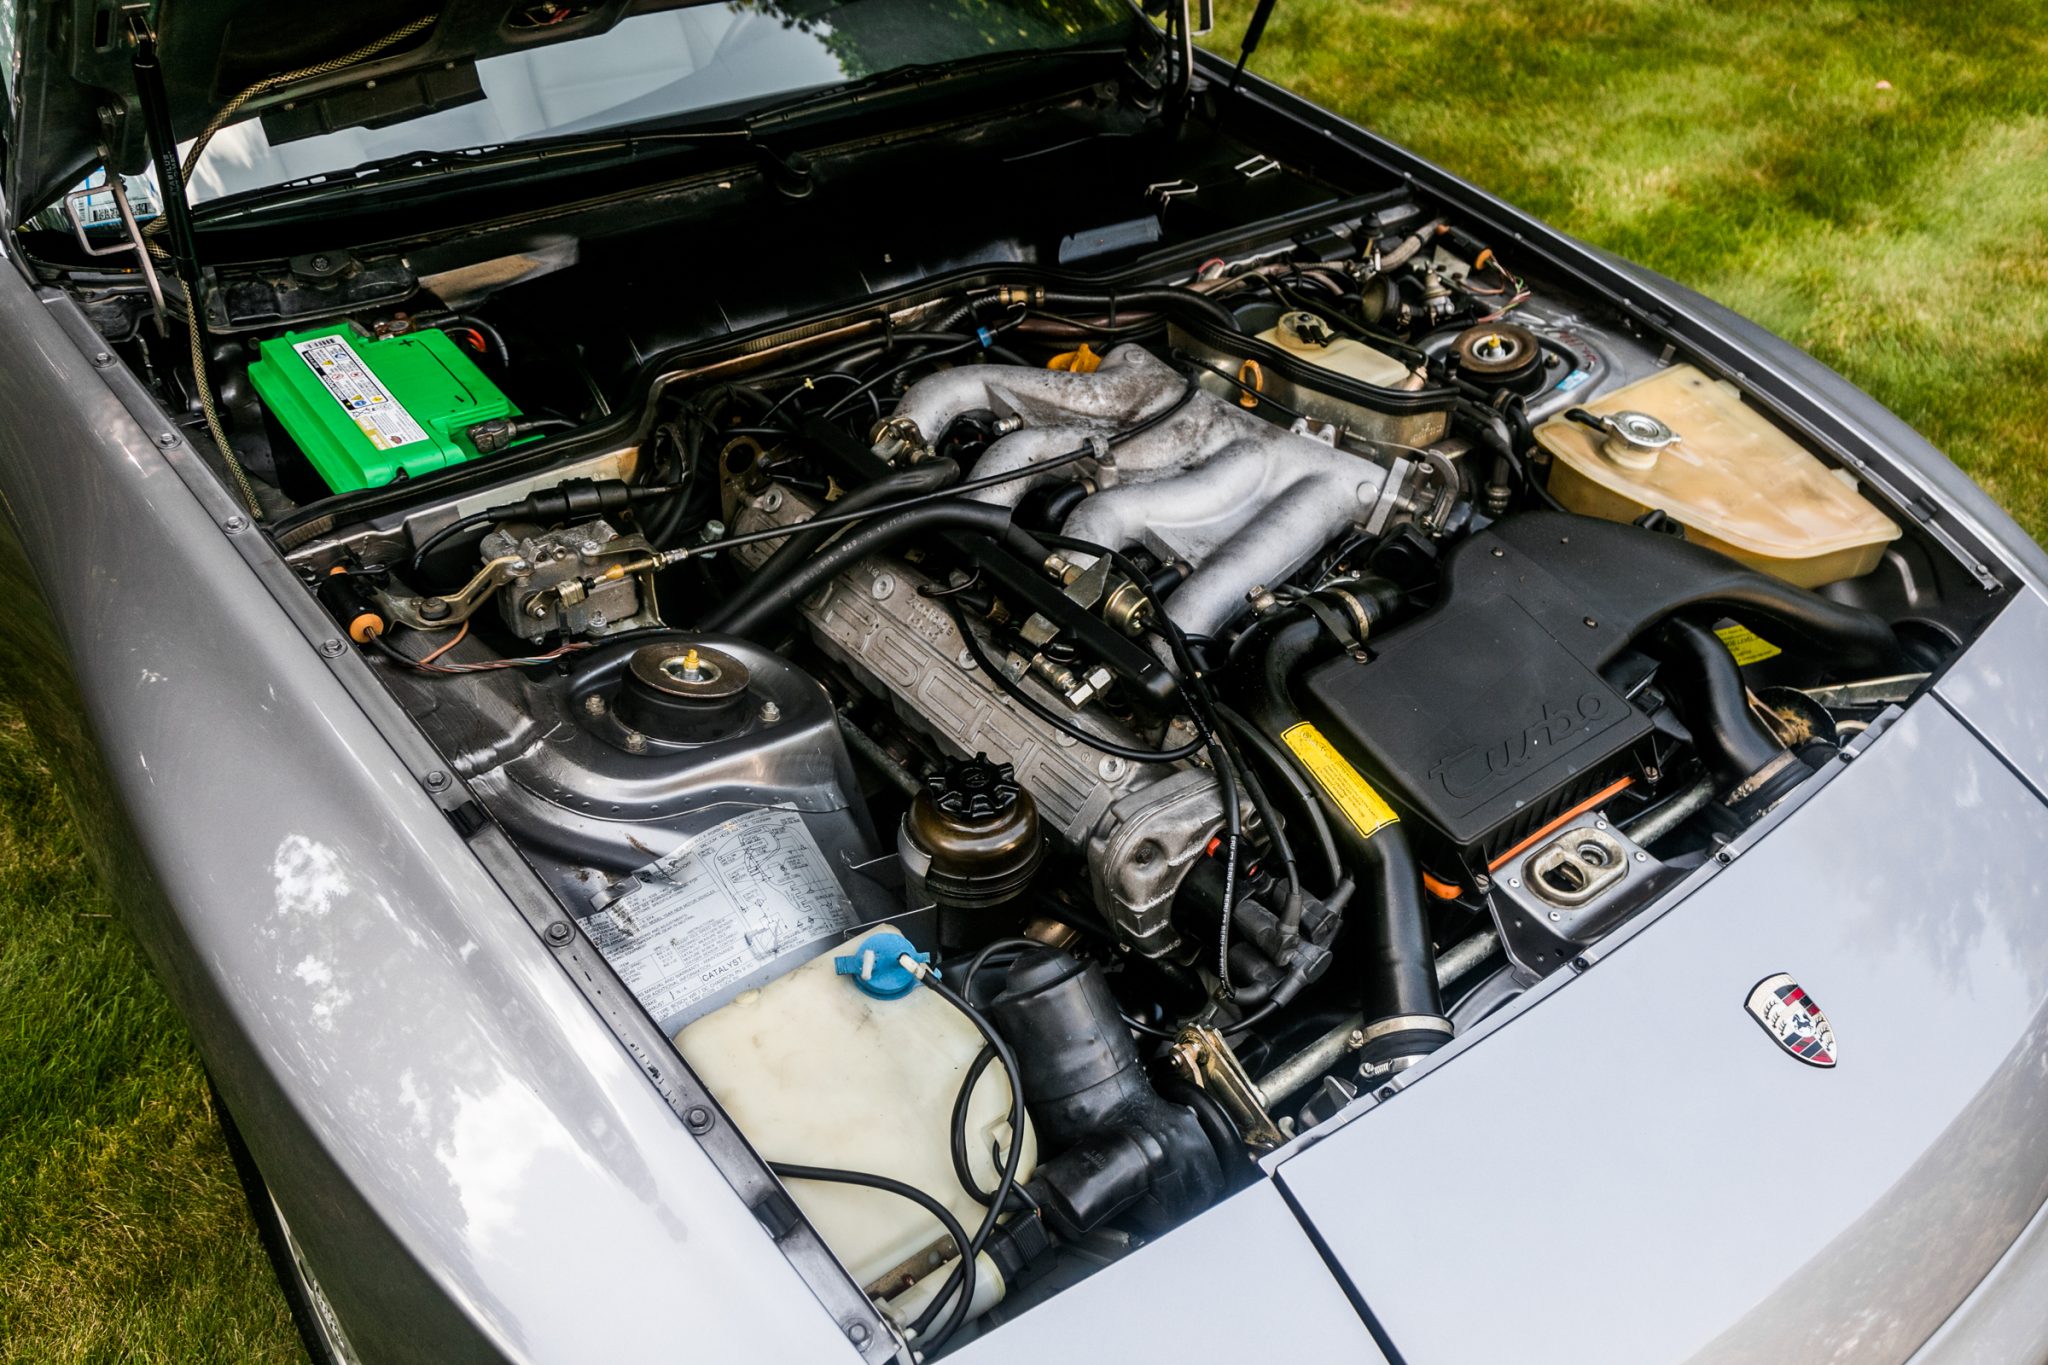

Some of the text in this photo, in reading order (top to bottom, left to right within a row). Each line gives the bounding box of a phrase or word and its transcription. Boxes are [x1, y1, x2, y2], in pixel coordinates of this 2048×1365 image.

[1428, 692, 1605, 799] turbo
[1226, 862, 1234, 881] BERU
[1222, 893, 1230, 913] BERU
[700, 955, 744, 983] CATALYST
